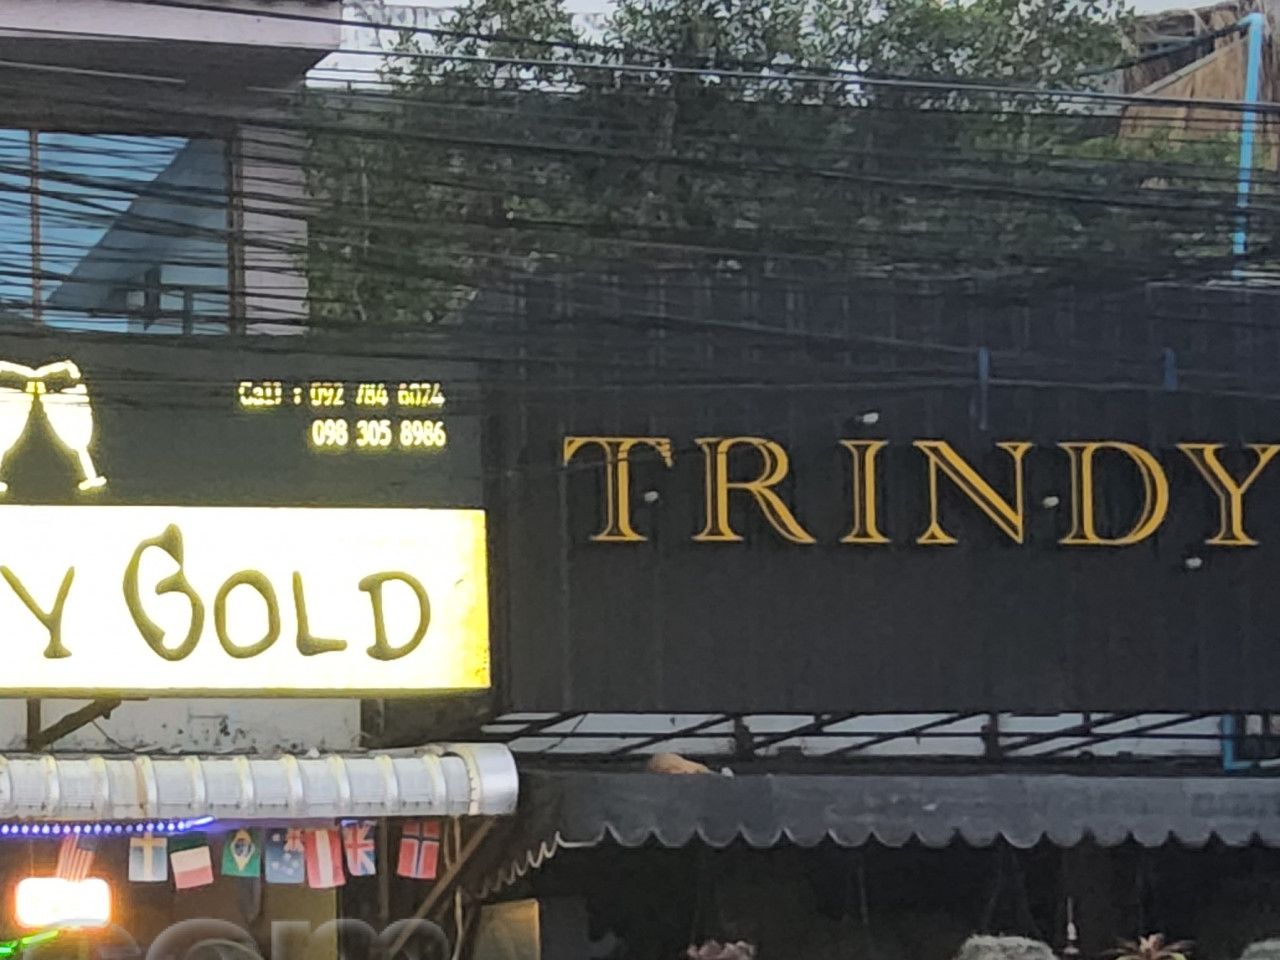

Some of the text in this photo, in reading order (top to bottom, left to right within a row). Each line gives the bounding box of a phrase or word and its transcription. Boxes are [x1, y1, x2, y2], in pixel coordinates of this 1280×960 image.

[238, 381, 282, 405] Call
[311, 418, 446, 447] 098 305 8986
[562, 436, 1280, 546] TRINDY
[122, 523, 431, 662] GOLD
